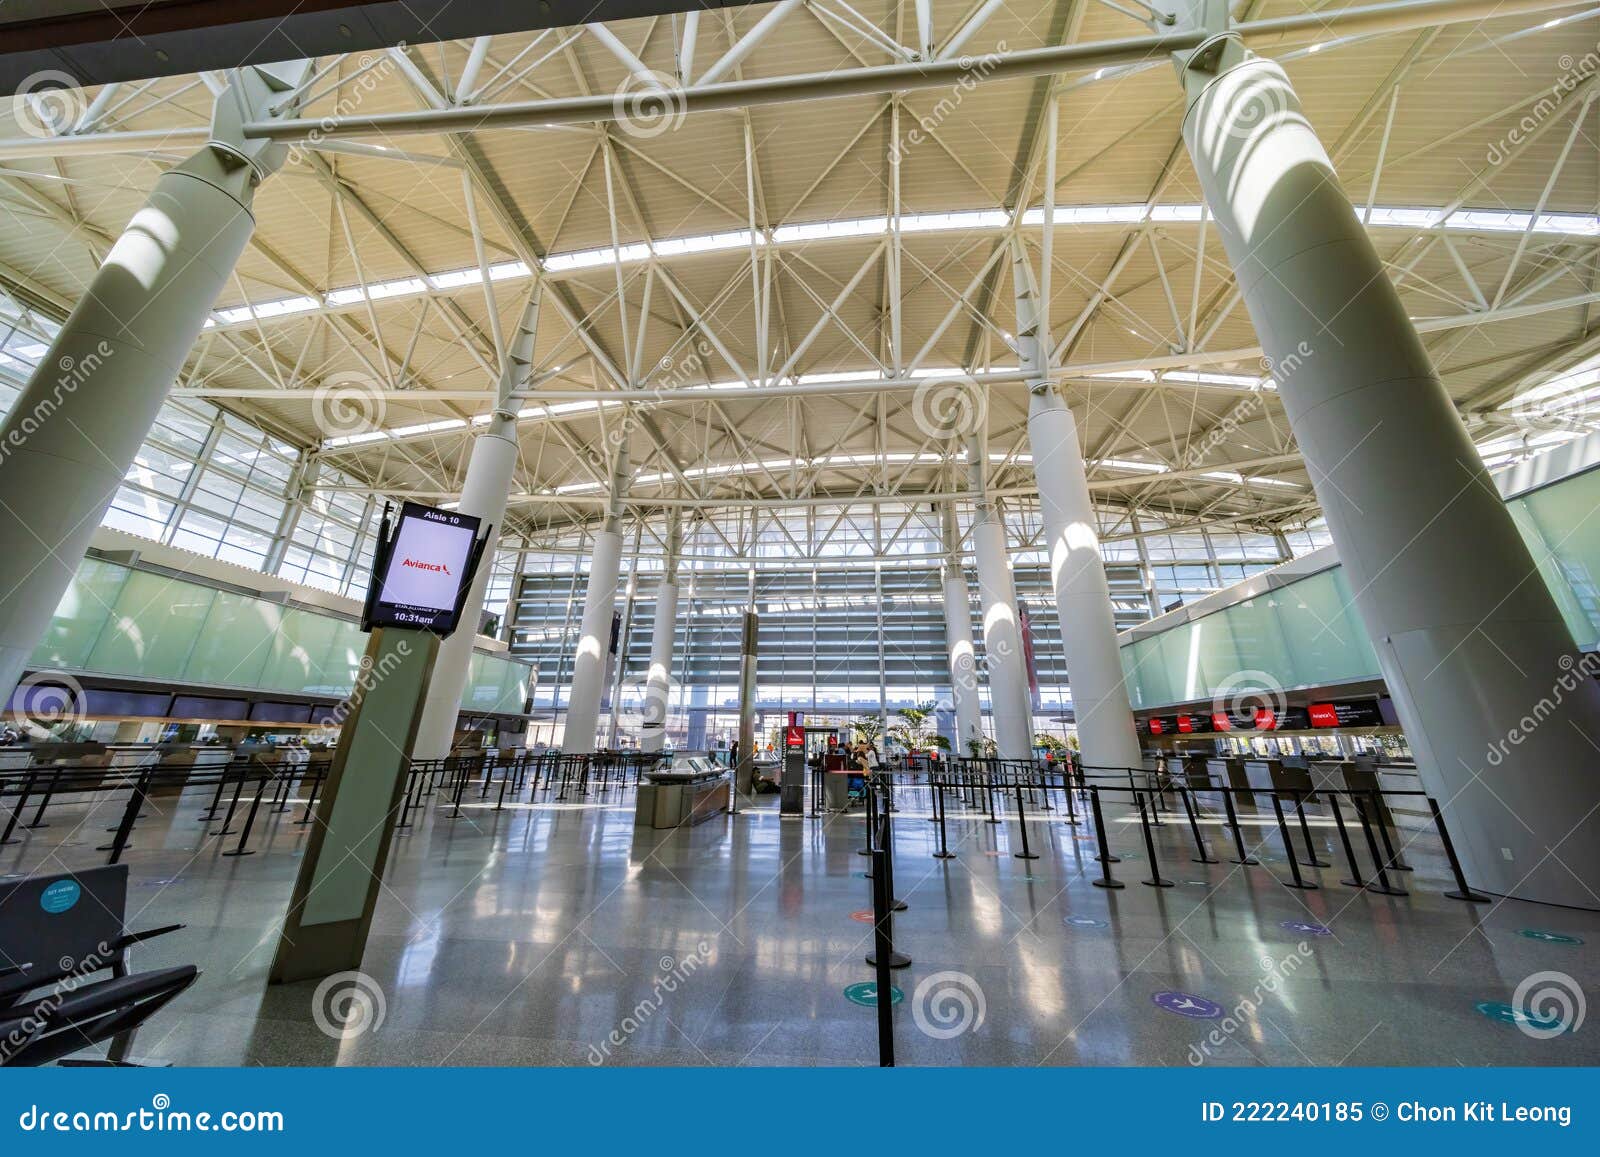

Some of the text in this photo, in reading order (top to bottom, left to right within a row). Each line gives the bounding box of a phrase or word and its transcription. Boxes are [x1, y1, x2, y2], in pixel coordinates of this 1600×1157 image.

[424, 511, 460, 525] Aisle 10
[402, 558, 441, 572] Avianca
[394, 612, 434, 624] 10:31am
